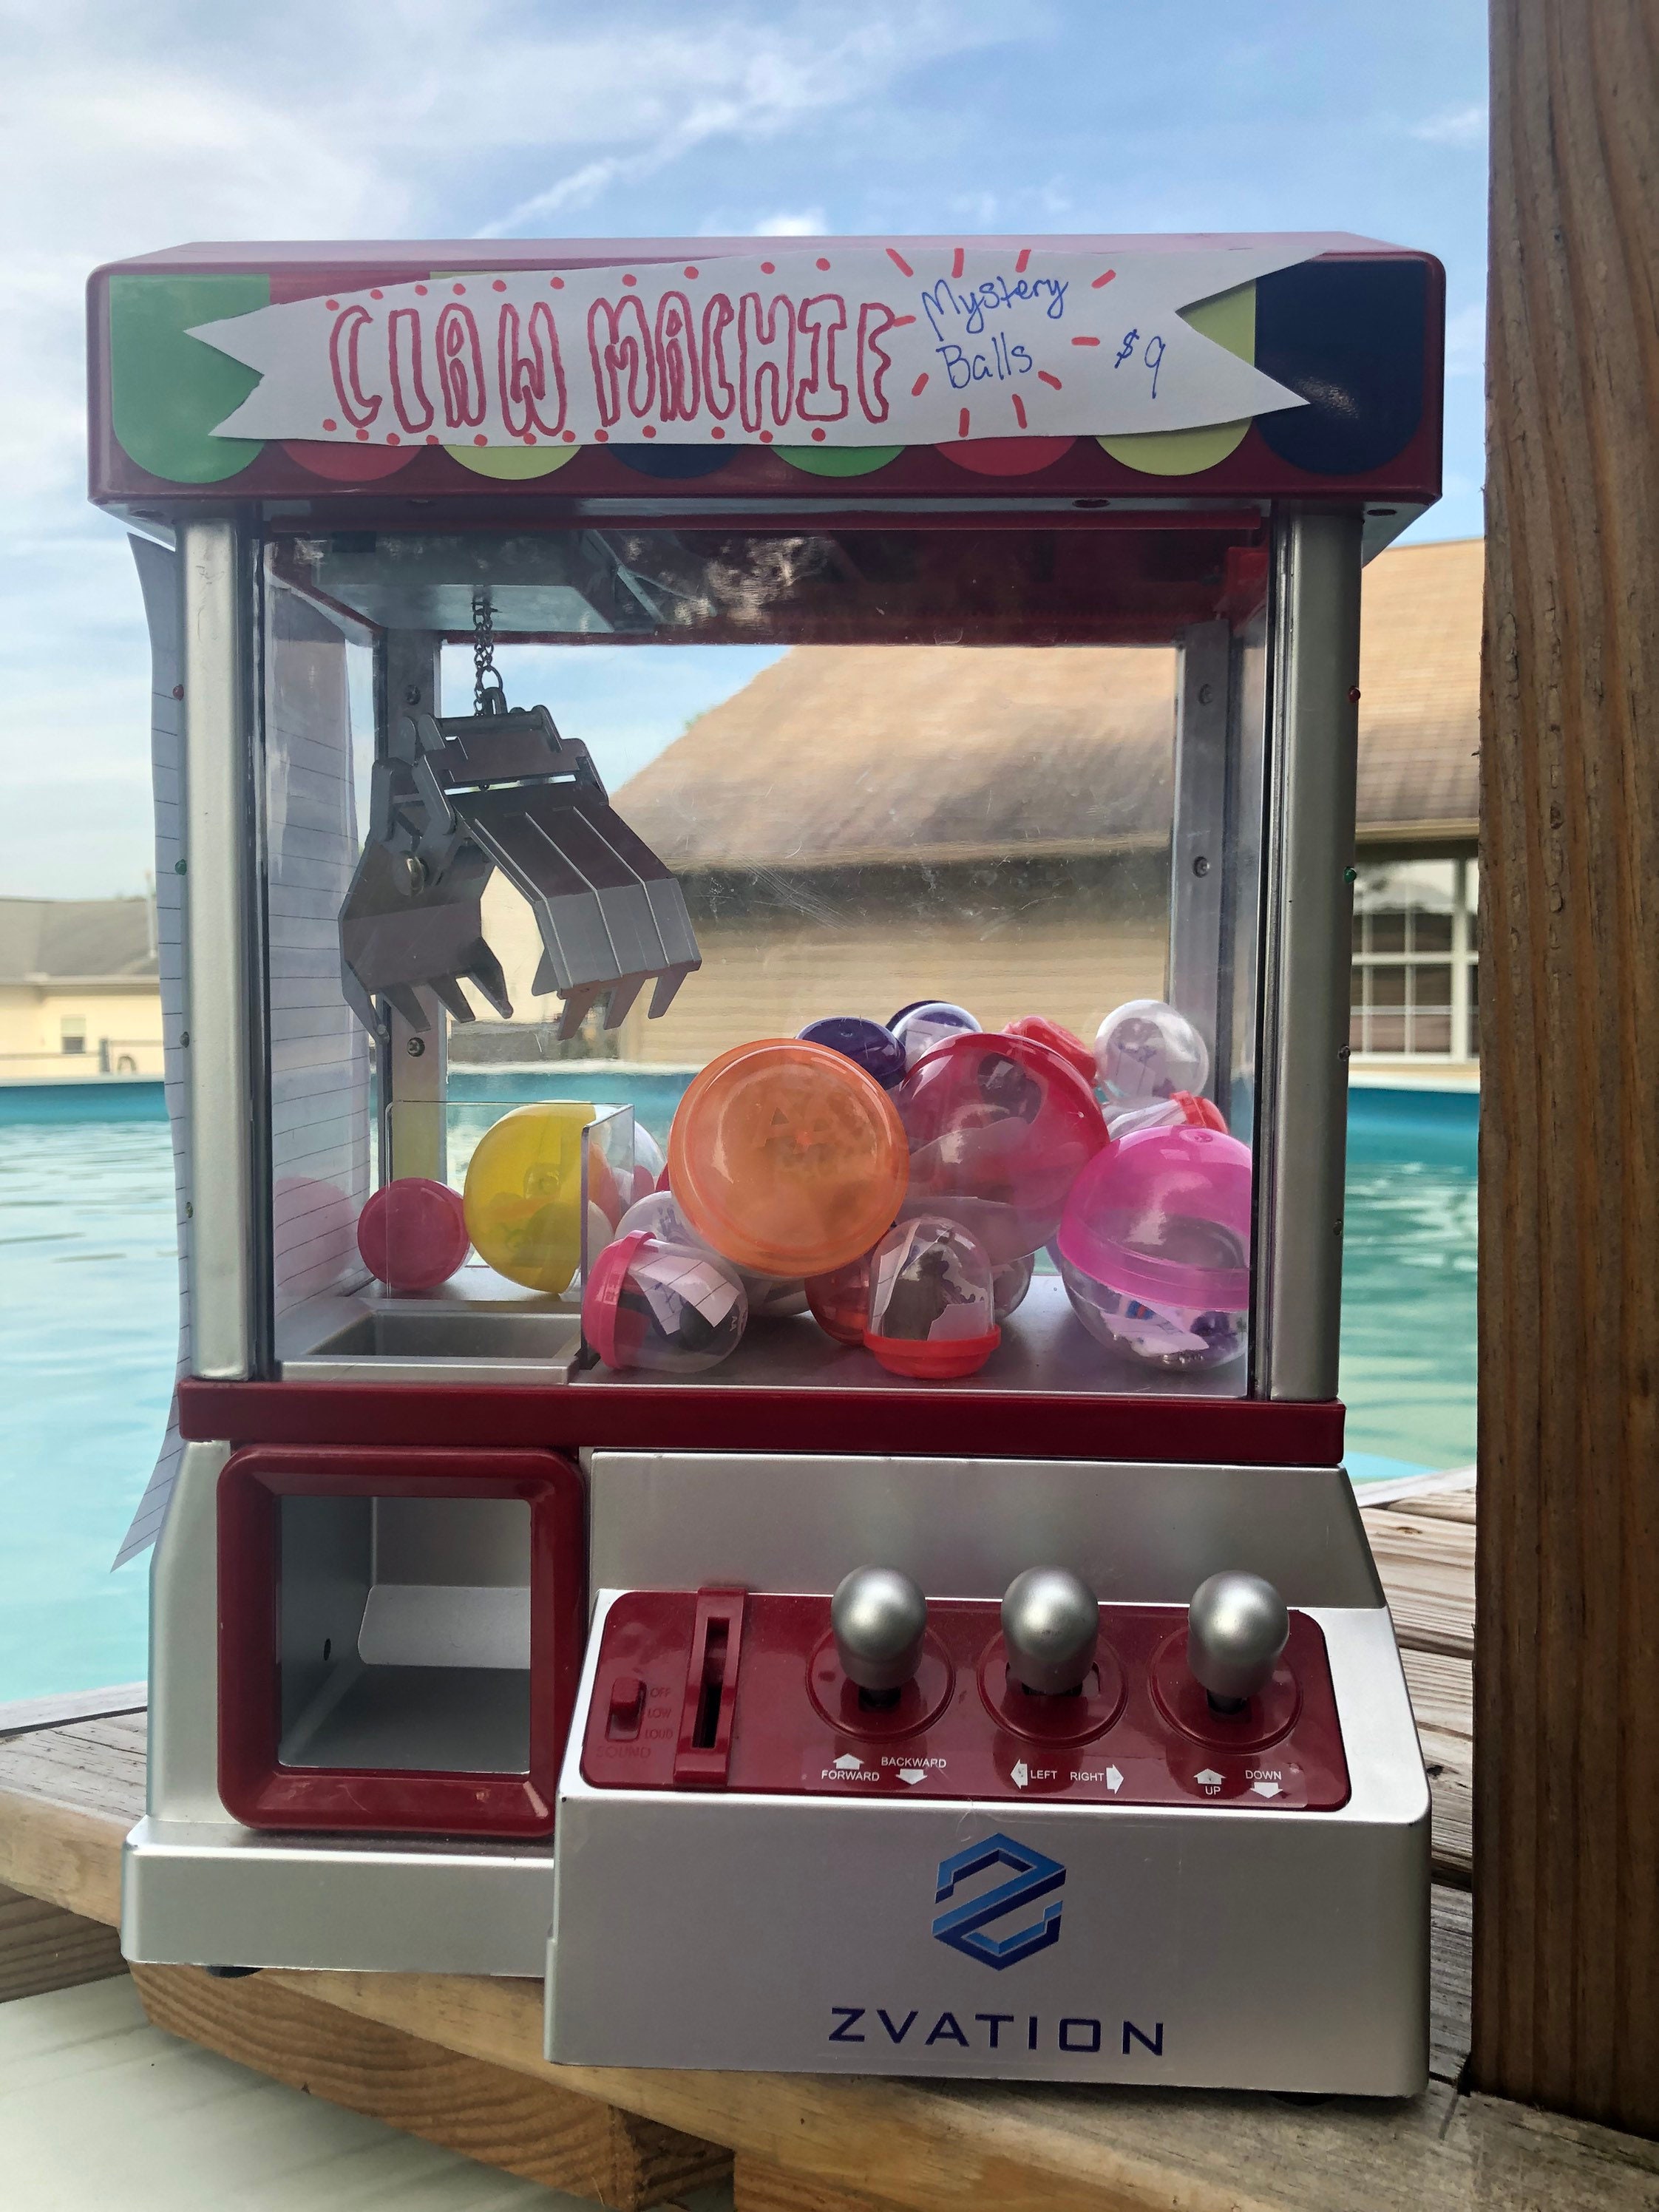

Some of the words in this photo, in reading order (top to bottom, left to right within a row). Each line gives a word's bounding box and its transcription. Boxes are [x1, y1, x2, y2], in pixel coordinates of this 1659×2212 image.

[922, 275, 1069, 342] Mystery
[936, 332, 1033, 389] Balls
[1114, 328, 1166, 399] $9
[330, 302, 568, 437] CLAW
[650, 1686, 671, 1698] OFF
[647, 1707, 672, 1719] LOW
[644, 1728, 674, 1740] LOUD
[595, 1745, 651, 1759] SOUND
[881, 1757, 947, 1769] BACKWARD
[821, 1770, 881, 1782] FORWARD
[1030, 1769, 1057, 1780] LEFT
[1069, 1771, 1105, 1782] RIGHT
[1244, 1769, 1283, 1780] DOWN
[1204, 1785, 1221, 1796] UP
[828, 2006, 1164, 2057] ZVATION
